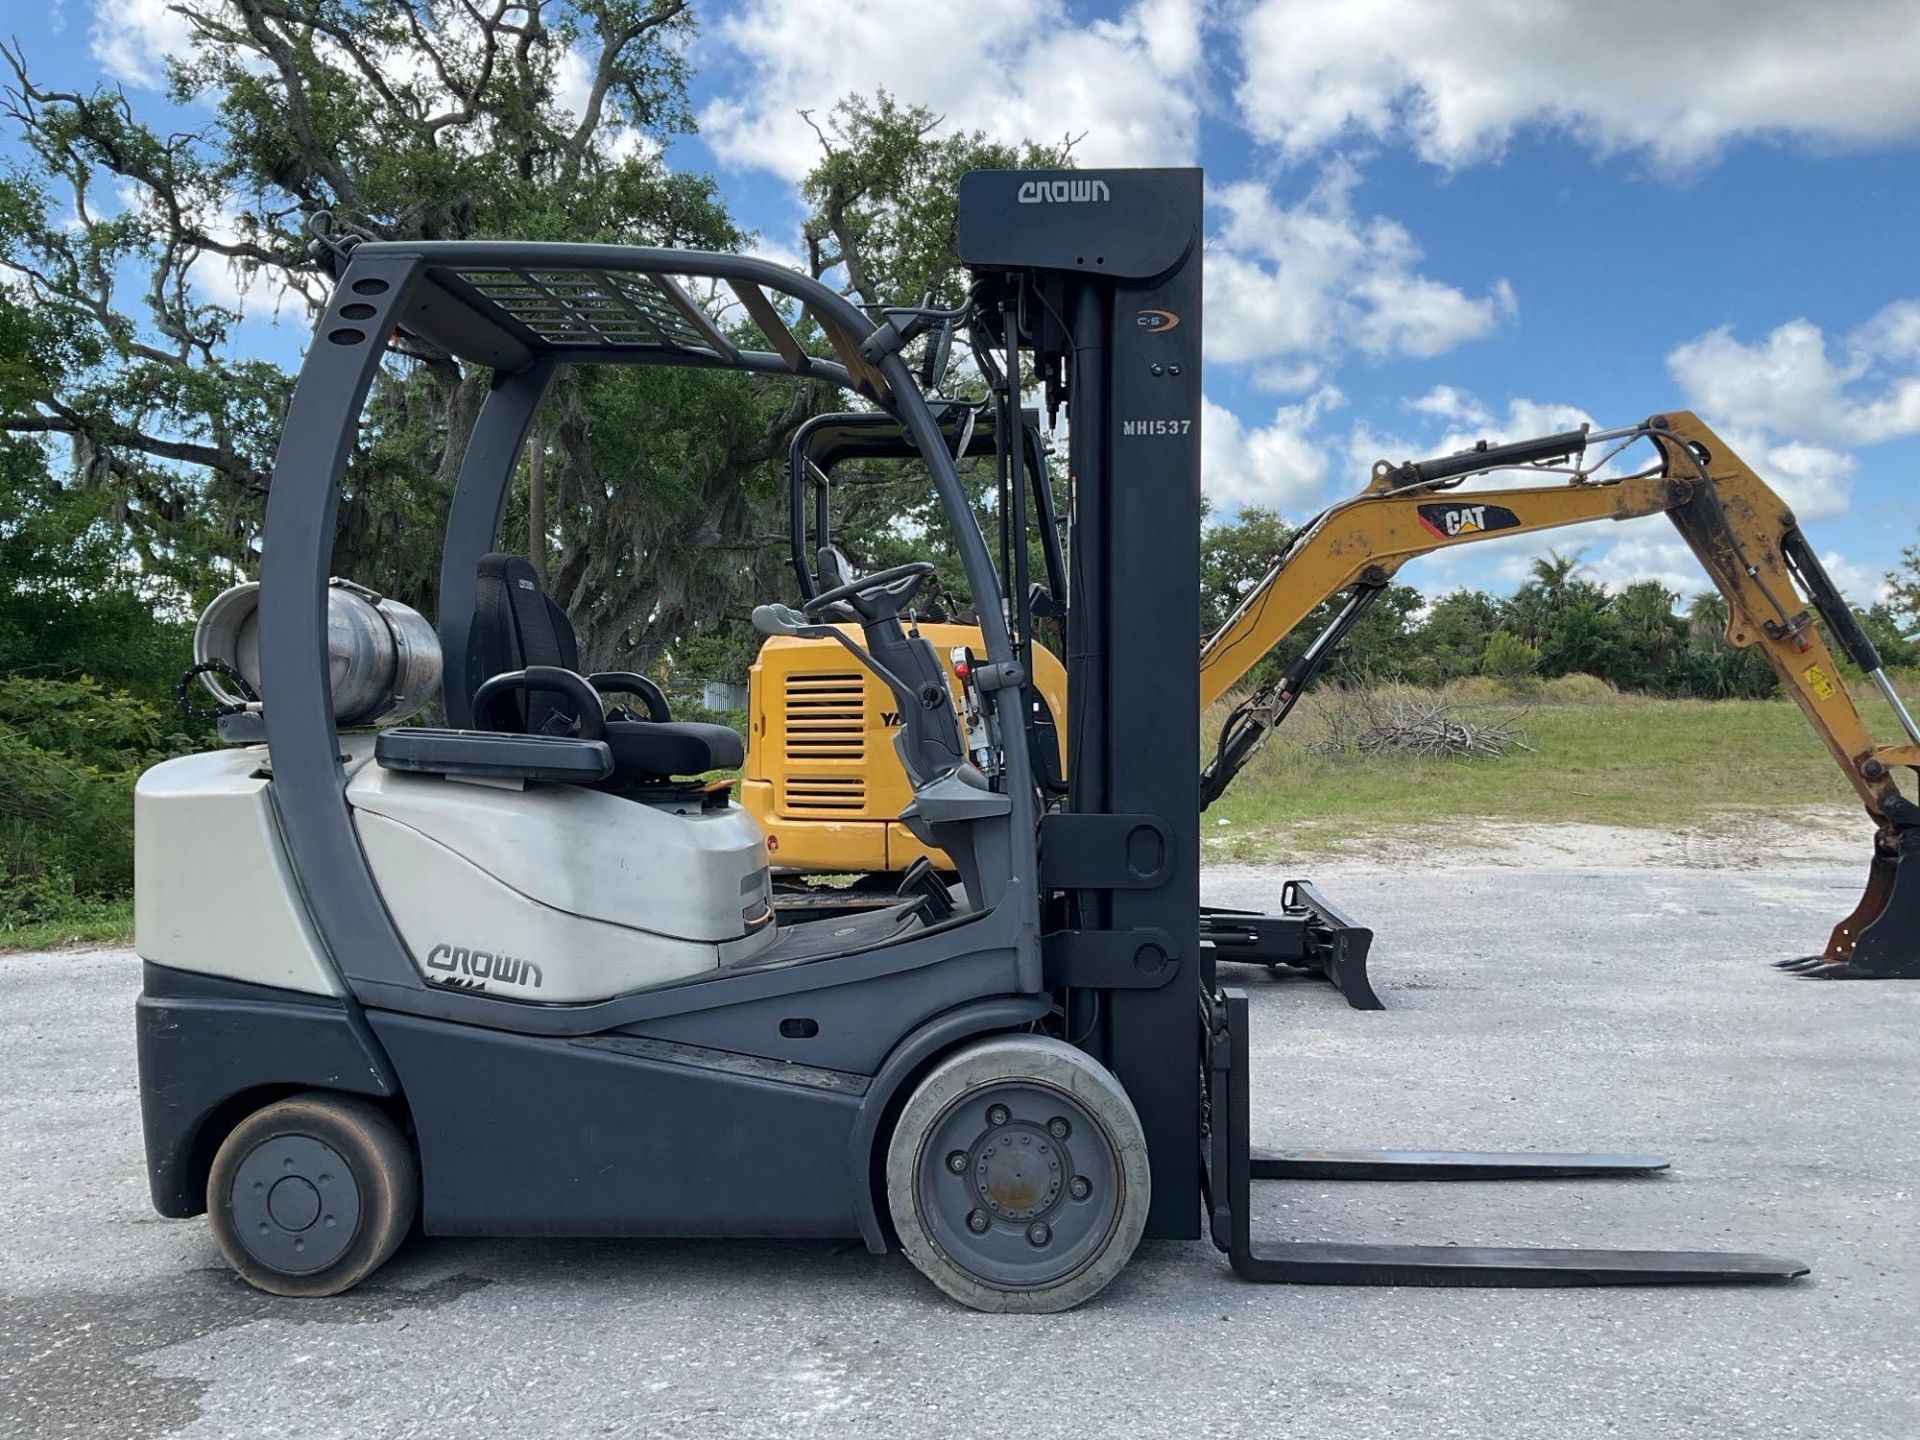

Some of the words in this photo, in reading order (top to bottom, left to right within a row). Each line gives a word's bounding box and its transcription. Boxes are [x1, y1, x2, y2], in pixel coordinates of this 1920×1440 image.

[1018, 180, 1110, 203] CROWN
[1445, 506, 1486, 536] CAT
[426, 943, 543, 988] CROWN
